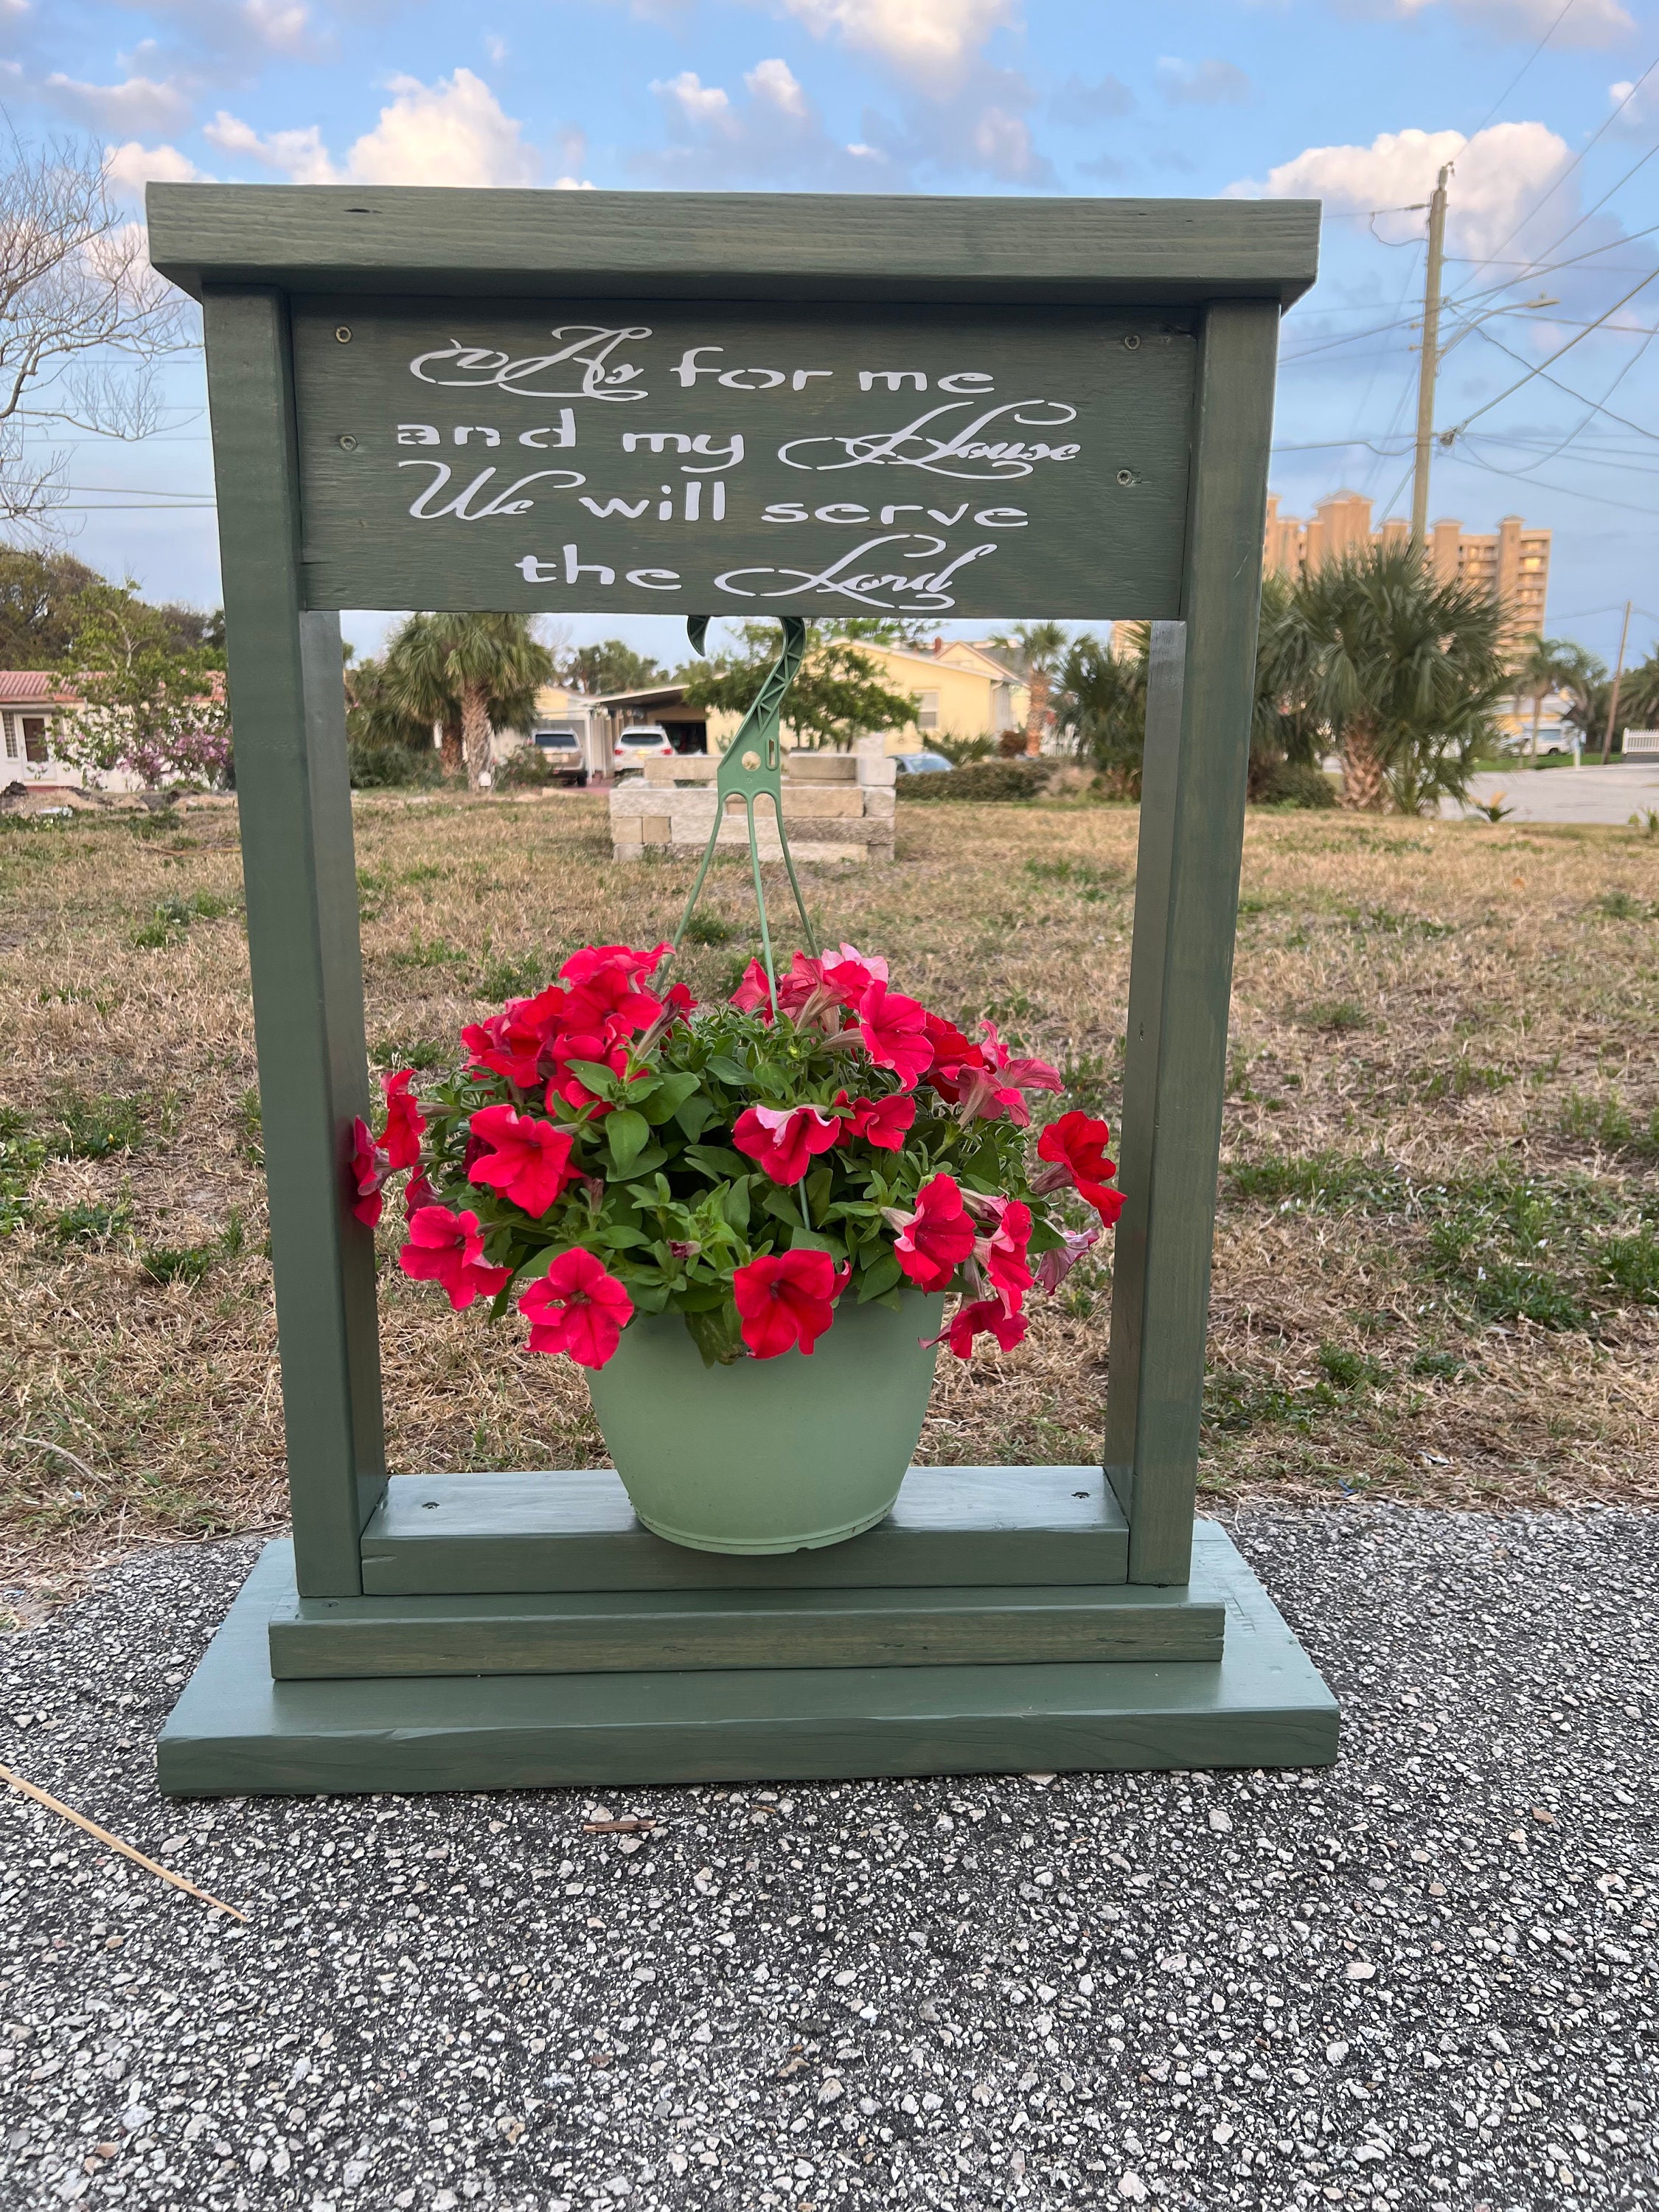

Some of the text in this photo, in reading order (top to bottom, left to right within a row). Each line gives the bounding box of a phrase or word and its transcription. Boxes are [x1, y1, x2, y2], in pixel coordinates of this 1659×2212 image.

[409, 326, 995, 402] As for me
[397, 400, 1081, 480] and my House
[398, 460, 1029, 527] We will serve
[515, 534, 998, 611] the Lord
